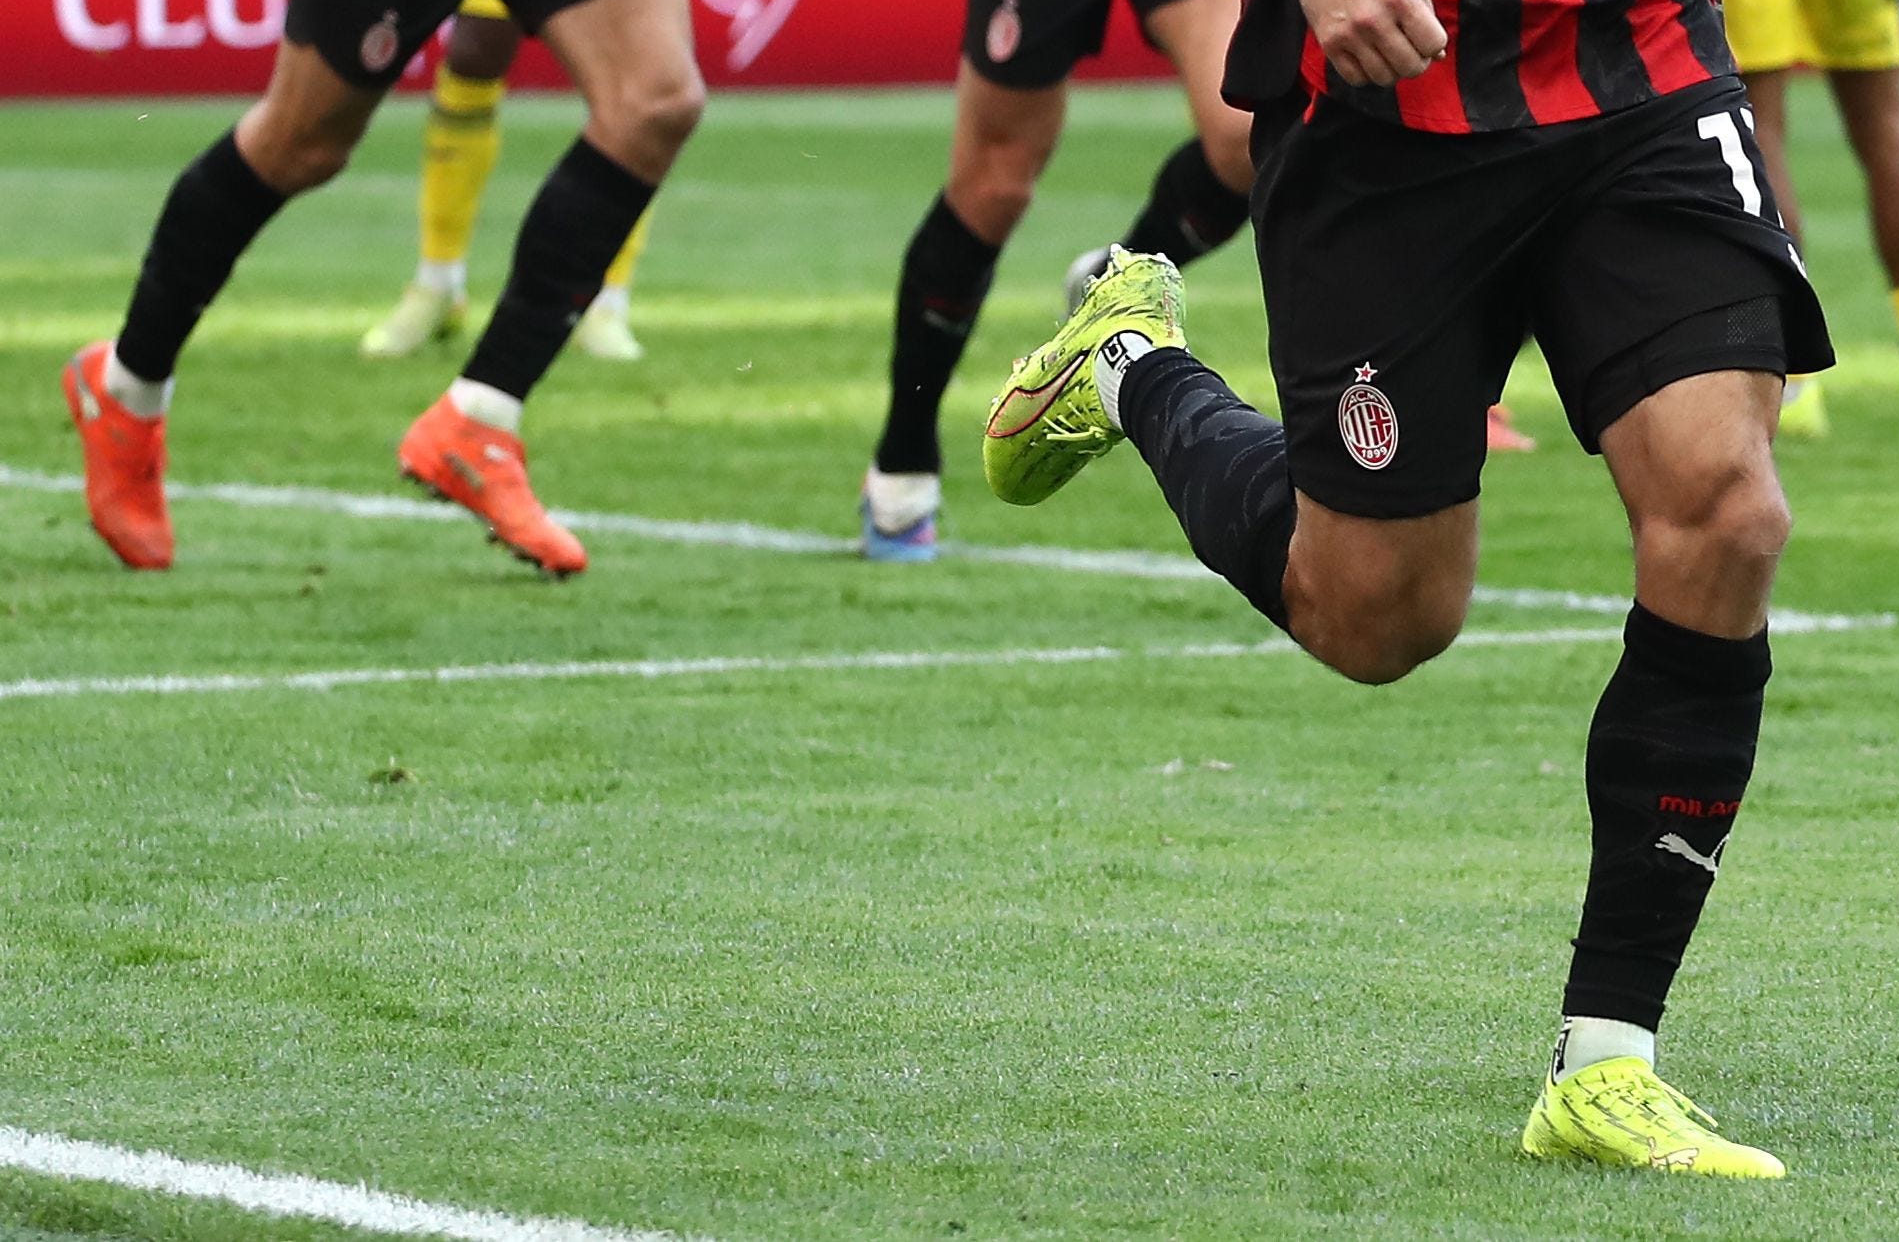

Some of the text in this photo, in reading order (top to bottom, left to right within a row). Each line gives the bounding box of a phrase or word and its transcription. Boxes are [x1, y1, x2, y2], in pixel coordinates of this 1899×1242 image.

[1697, 107, 1785, 229] 1
[1348, 390, 1379, 408] ACM
[1361, 445, 1388, 459] 1899
